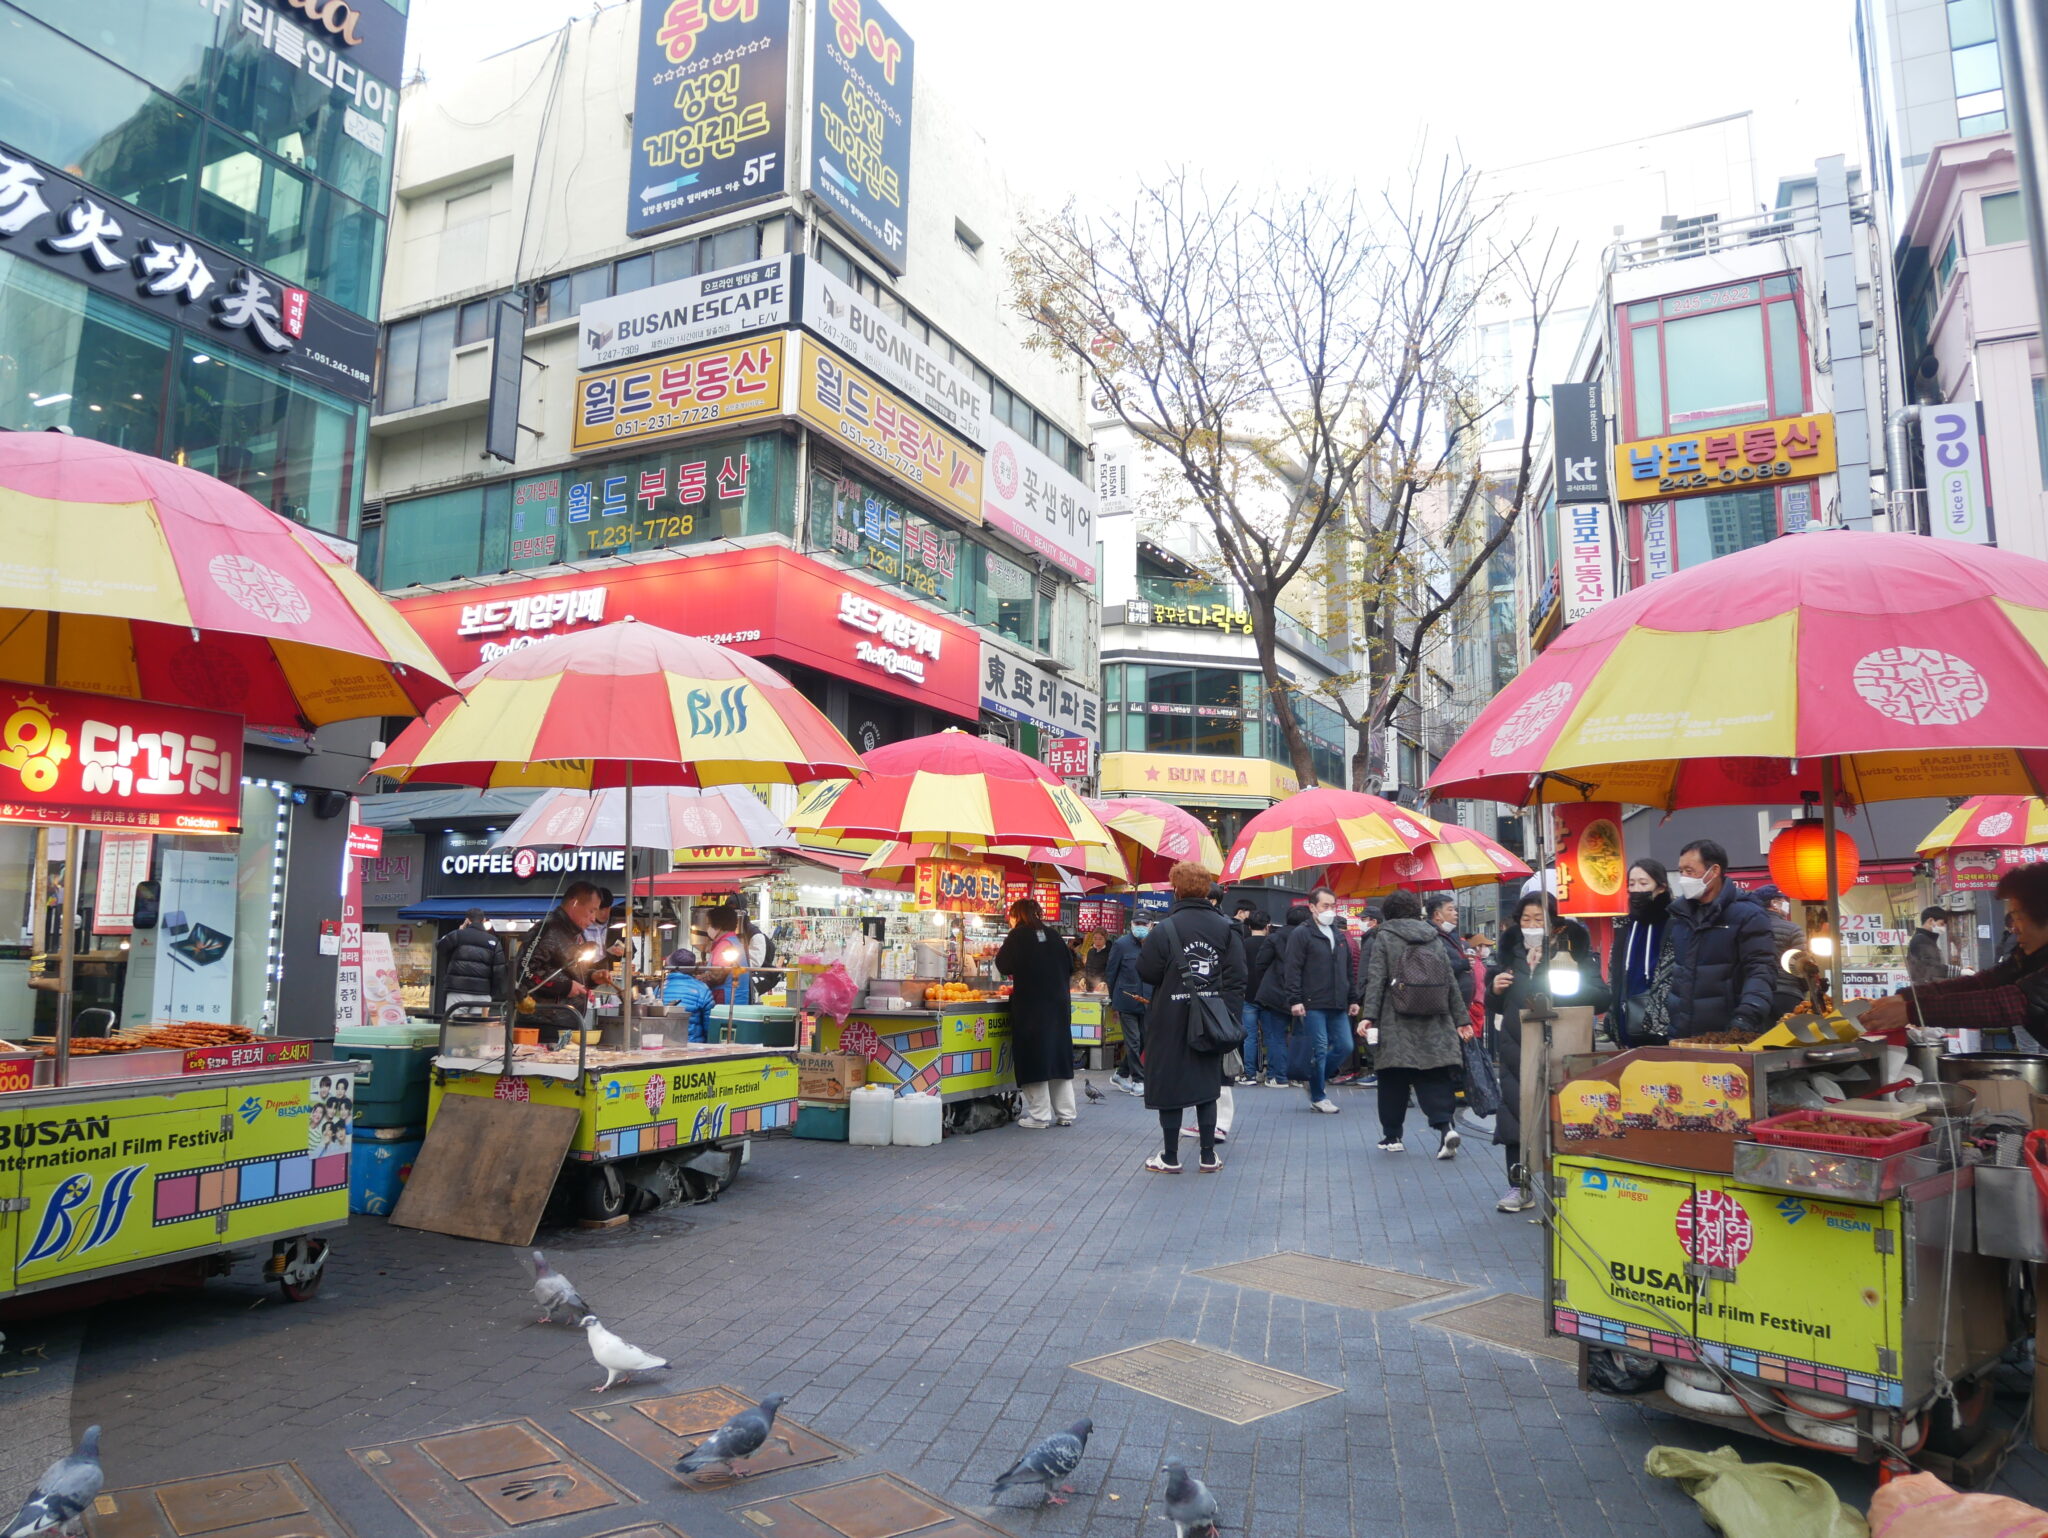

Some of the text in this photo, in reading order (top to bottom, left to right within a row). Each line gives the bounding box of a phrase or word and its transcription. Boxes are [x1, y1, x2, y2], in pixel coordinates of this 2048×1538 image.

[828, 0, 902, 86] 동아
[242, 0, 394, 124] 리틀인디아
[675, 63, 740, 122] 성인
[842, 80, 884, 155] 성인
[642, 102, 770, 169] 게임랜드
[742, 152, 776, 187] 5F
[820, 102, 900, 208] 게임랜드
[883, 217, 903, 252] 5F
[703, 265, 777, 293] 오프라인 방탈출 4F
[291, 292, 304, 337] 마라탕
[618, 284, 784, 340] BUSAN ESCAPE
[1673, 286, 1750, 313] 245-7622
[758, 311, 778, 326] E/V
[305, 348, 371, 383] T.051.242.1888
[850, 304, 911, 374] BUSAN
[915, 359, 980, 422] ESCAPE
[615, 405, 719, 436] 051-231-7728
[1588, 387, 1598, 442] korea telecom
[840, 420, 922, 481] 051-231-7728
[1934, 414, 1969, 467] CU
[1100, 463, 1108, 500] ESCAPE
[1109, 465, 1117, 497] BUSAN
[1565, 456, 1597, 482] kt
[1659, 461, 1791, 493] 242-0089
[515, 479, 559, 506] 상가임대
[1023, 466, 1091, 547] 꽃샘헤어
[1952, 480, 1964, 524] Nice to
[588, 514, 693, 550] T.231-7728
[1012, 522, 1031, 543] TOTAL
[1034, 534, 1056, 557] BEAUTY
[1059, 550, 1078, 570] SALON
[457, 587, 608, 636] 보드게임카페
[838, 592, 941, 660] 보드게임카페
[985, 655, 1096, 733] 東亞데파트
[0, 708, 232, 797] 왕 닭꼬치
[1050, 750, 1087, 773] 부동산
[1168, 767, 1248, 785] BUN CHA
[176, 815, 218, 829] Chicken
[441, 850, 626, 875] COFFEE ROUTINE
[340, 971, 357, 984] 최대
[1843, 973, 1888, 985] iphone 14
[189, 1057, 206, 1069] 대왕
[231, 1047, 264, 1066] 닭꼬치
[267, 1053, 277, 1062] or
[278, 1044, 310, 1061] 소세지
[809, 1059, 834, 1068] PARK
[674, 1071, 716, 1091] BUSAN
[719, 1085, 733, 1098] Film
[735, 1081, 760, 1095] Festival
[265, 1096, 301, 1110] Dynamic
[278, 1105, 312, 1117] BUSAN
[122, 1134, 163, 1157] Film
[168, 1126, 234, 1153] Festival
[1613, 1177, 1638, 1191] Nice
[1618, 1190, 1648, 1202] junggu
[1694, 1190, 1741, 1222] 부산
[1810, 1204, 1856, 1220] Dynamic
[1826, 1216, 1871, 1233] BUSAN
[1610, 1261, 1706, 1297] BUSAN
[1610, 1284, 1831, 1339] International Film Festival
